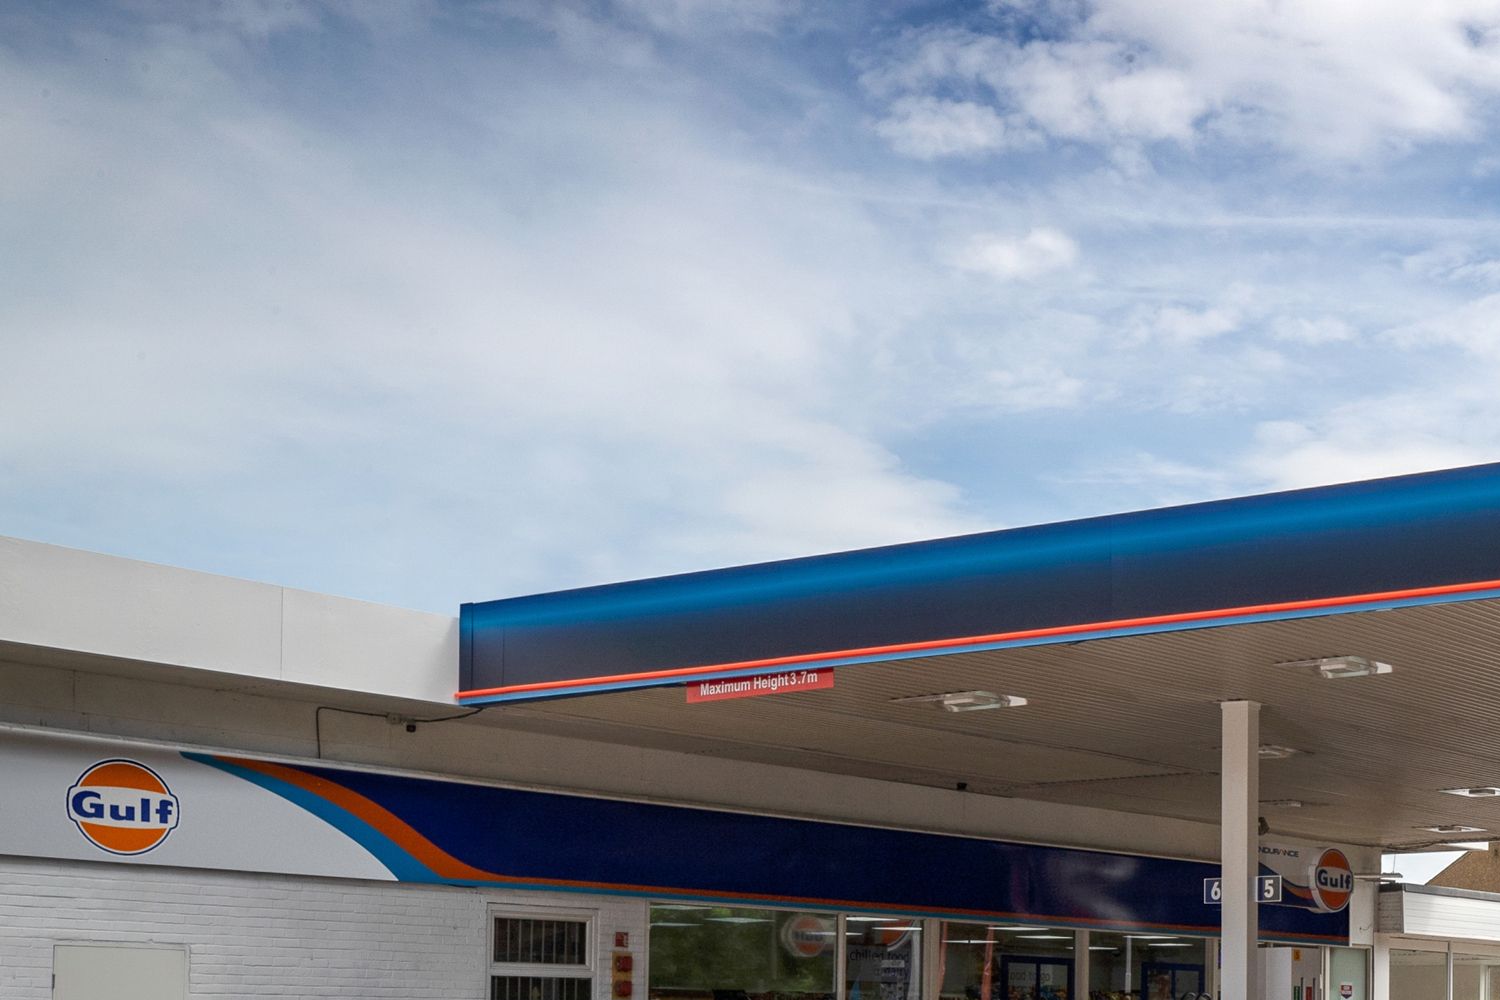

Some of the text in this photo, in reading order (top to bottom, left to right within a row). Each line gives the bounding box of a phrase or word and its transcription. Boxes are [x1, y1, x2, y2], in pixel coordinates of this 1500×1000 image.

[699, 671, 818, 697] Maximum Height 3.7m
[71, 790, 174, 824] Gulf
[1258, 846, 1299, 858] NDURANCE
[1263, 879, 1274, 898] 5
[1317, 868, 1351, 890] Gulf
[1211, 881, 1221, 900] 6
